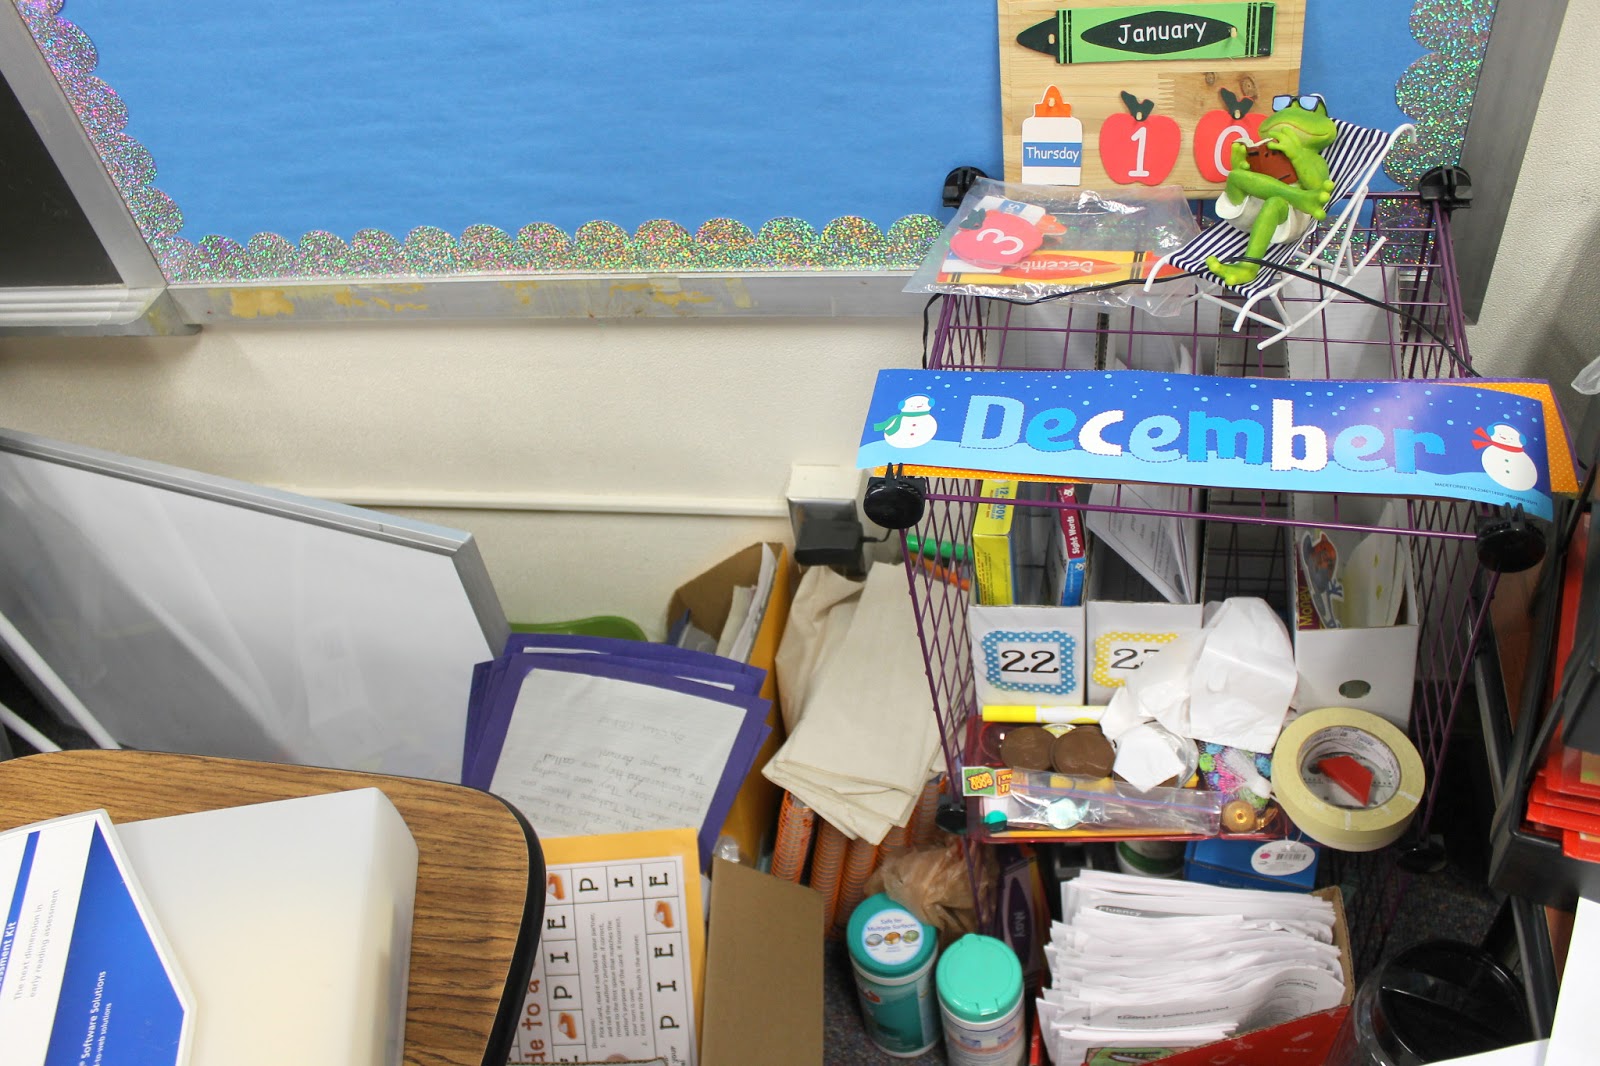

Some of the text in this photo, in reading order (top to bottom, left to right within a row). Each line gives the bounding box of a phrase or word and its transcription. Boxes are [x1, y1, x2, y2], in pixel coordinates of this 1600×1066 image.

[1117, 22, 1207, 45] January
[1025, 146, 1080, 163] Thursday
[1127, 126, 1150, 178] 1
[975, 227, 1024, 255] 3
[958, 394, 1448, 475] December
[1068, 515, 1078, 535] Words
[1071, 533, 1081, 555] Sight
[1000, 649, 1060, 674] 22
[1111, 648, 1160, 670] 2
[579, 877, 599, 892] P
[649, 873, 669, 887] E
[547, 915, 567, 930] E
[1099, 906, 1142, 917] Fluency
[6, 921, 16, 938] Kit
[13, 903, 42, 1000] The next dimension in
[30, 889, 60, 998] early reading assessment
[655, 944, 674, 957] E
[526, 978, 541, 994] a
[554, 985, 573, 1000] P
[82, 970, 106, 1058] Software Solutions
[518, 1002, 543, 1031] to
[660, 1016, 680, 1030] P
[94, 1002, 112, 1066] -to-web solutions
